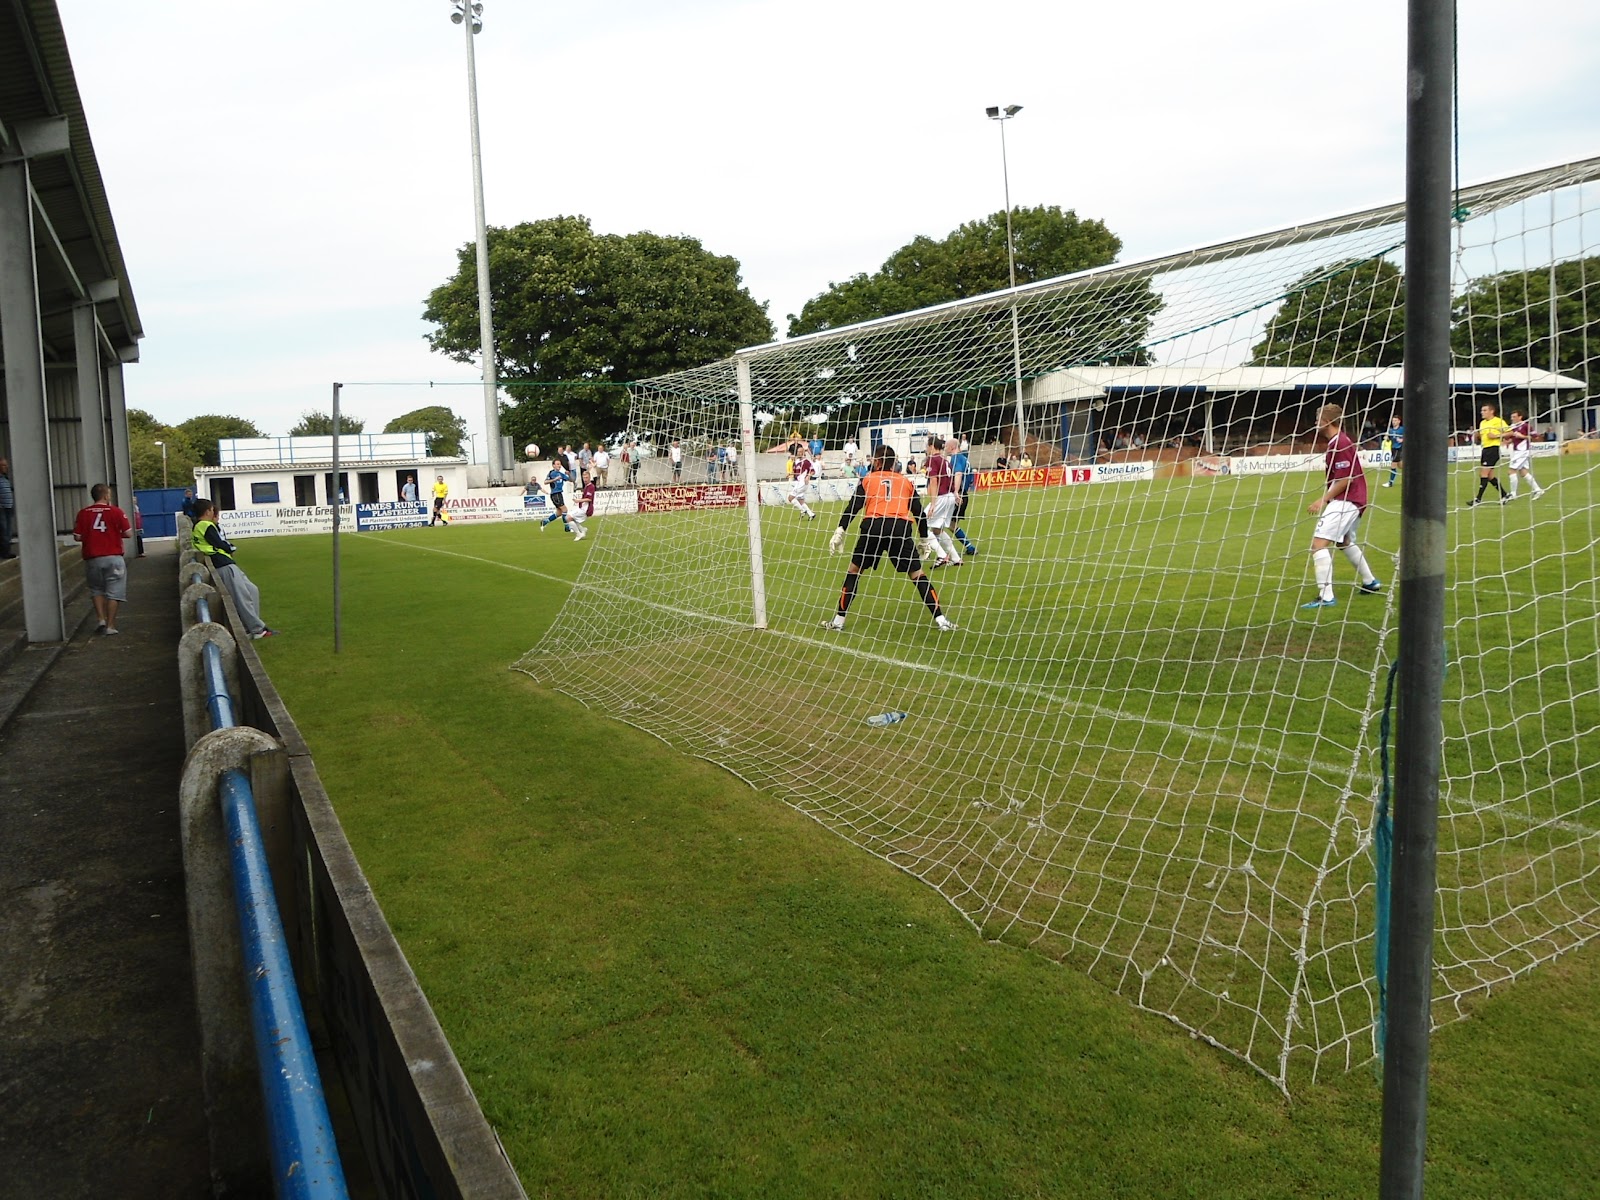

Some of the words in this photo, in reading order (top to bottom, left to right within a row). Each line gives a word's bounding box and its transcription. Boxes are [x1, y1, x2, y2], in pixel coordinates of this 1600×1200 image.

[1368, 452, 1394, 463] J.B.G
[1097, 466, 1125, 475] Stena
[1125, 464, 1145, 473] Line
[1249, 460, 1298, 471] Montpelier
[978, 468, 1045, 487] McKENZIE'S
[1077, 470, 1085, 481] S
[881, 479, 892, 502] 1
[359, 502, 392, 512] JAMES
[443, 497, 497, 509] YANMIX
[221, 510, 272, 520] CAMPBELL
[276, 508, 306, 518] Wither
[306, 506, 313, 516] &
[315, 505, 353, 516] Greehill
[371, 508, 420, 517] PLASTERER
[93, 512, 107, 533] 4
